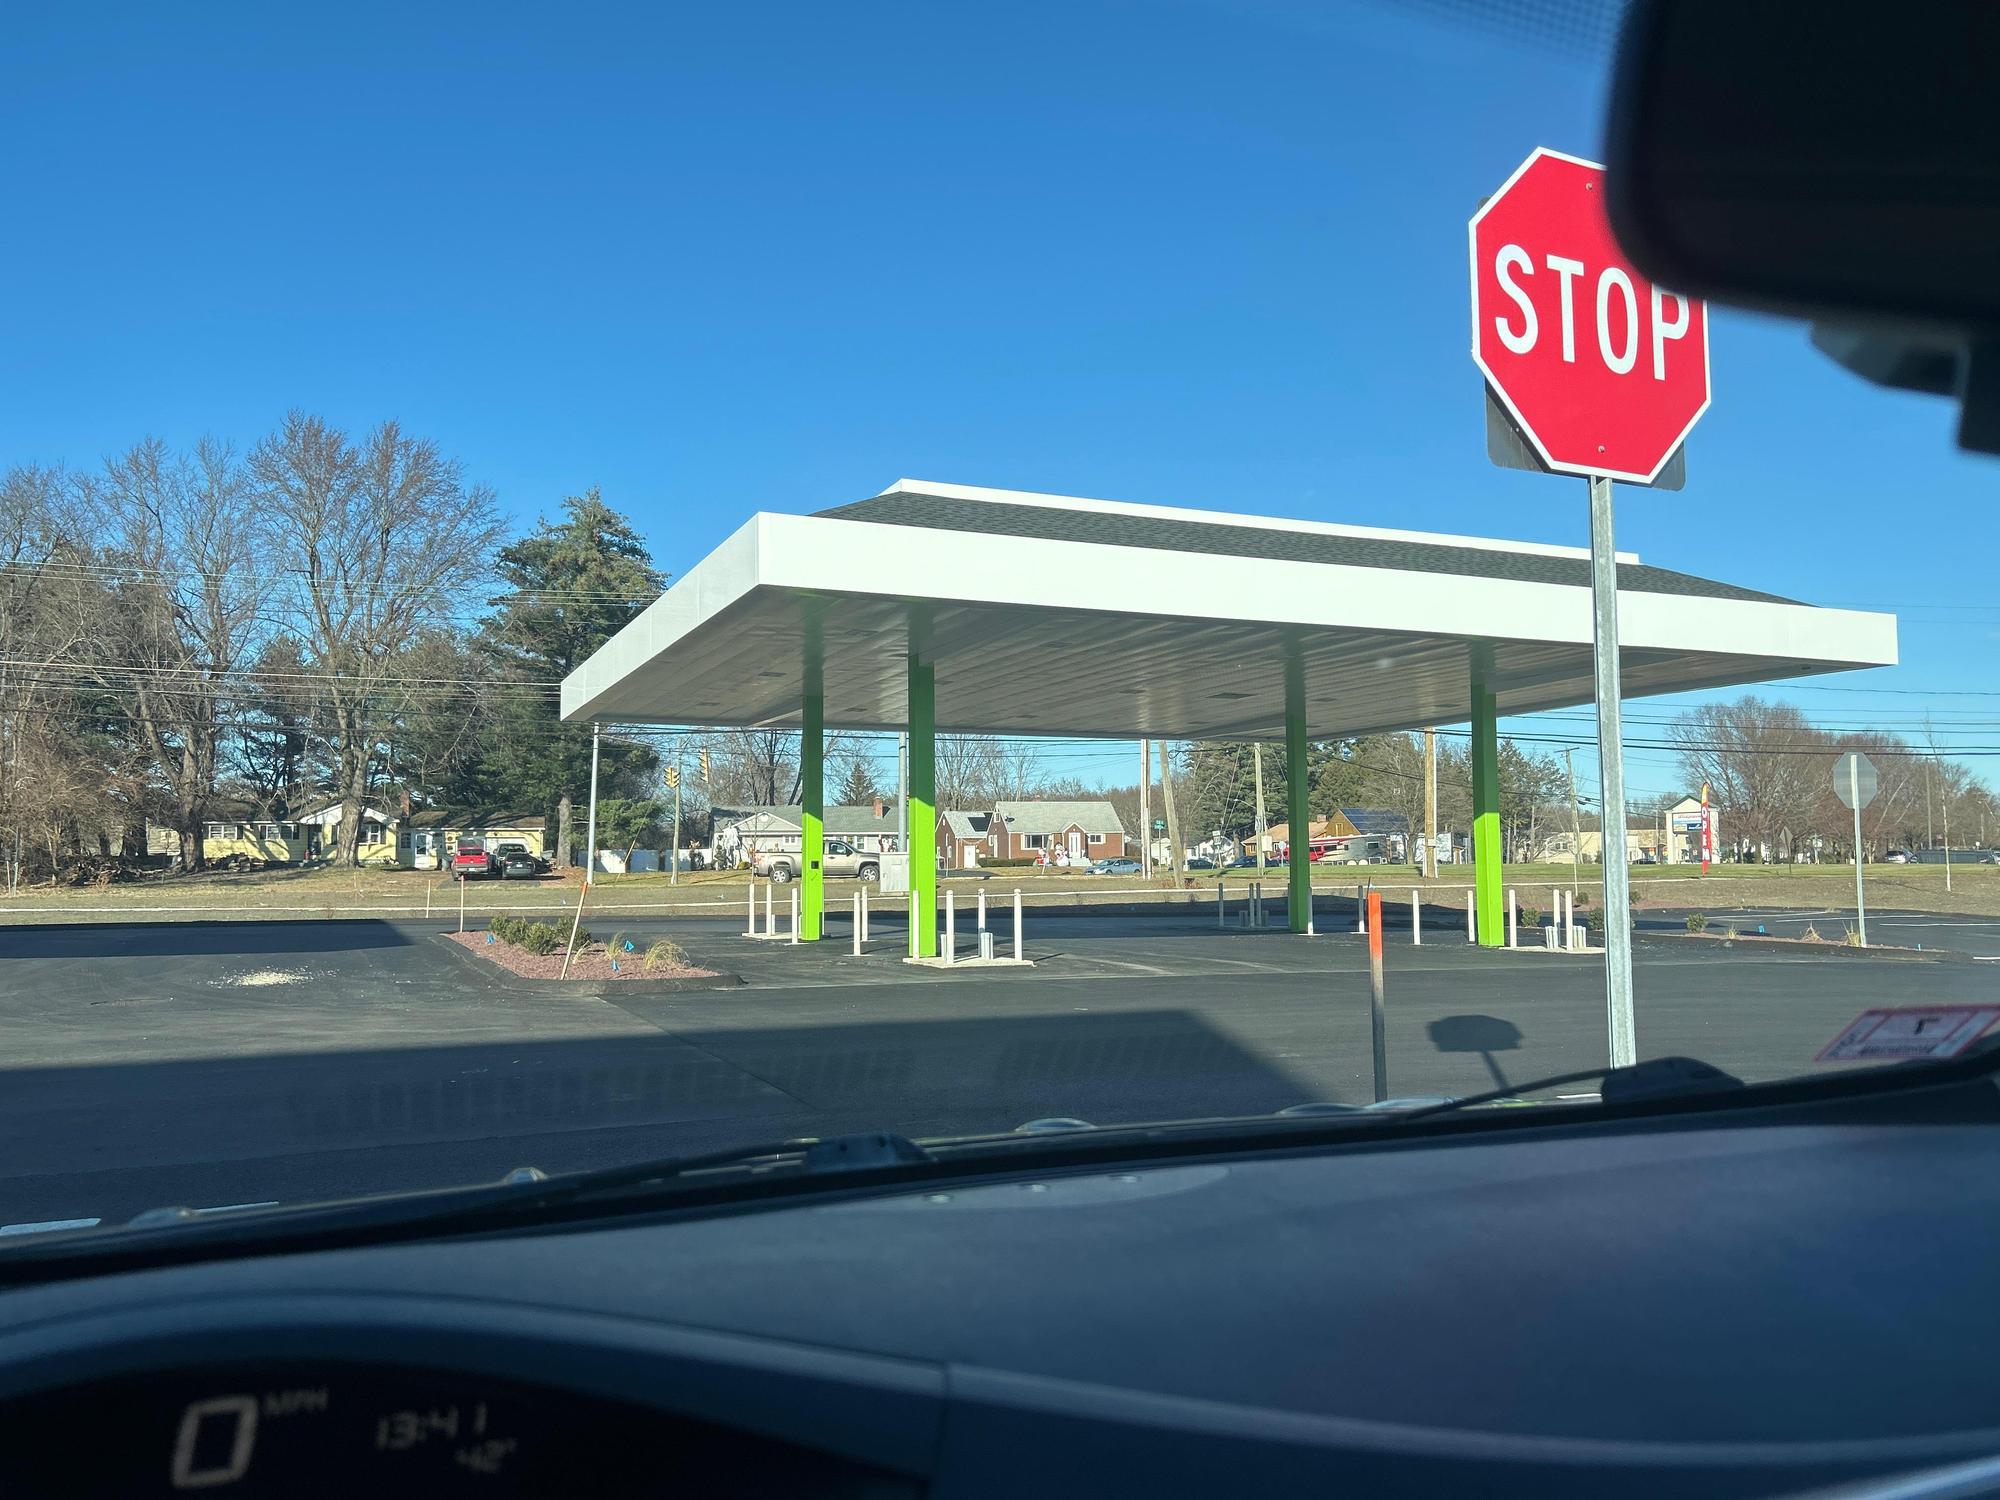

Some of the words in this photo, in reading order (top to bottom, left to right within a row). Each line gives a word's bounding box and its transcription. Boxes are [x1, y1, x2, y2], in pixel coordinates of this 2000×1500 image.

[1495, 244, 1690, 381] STOP
[1701, 806, 1710, 860] OPEN
[170, 1394, 258, 1489] 0
[264, 1386, 329, 1417] MPH
[375, 1402, 488, 1450] 13:41
